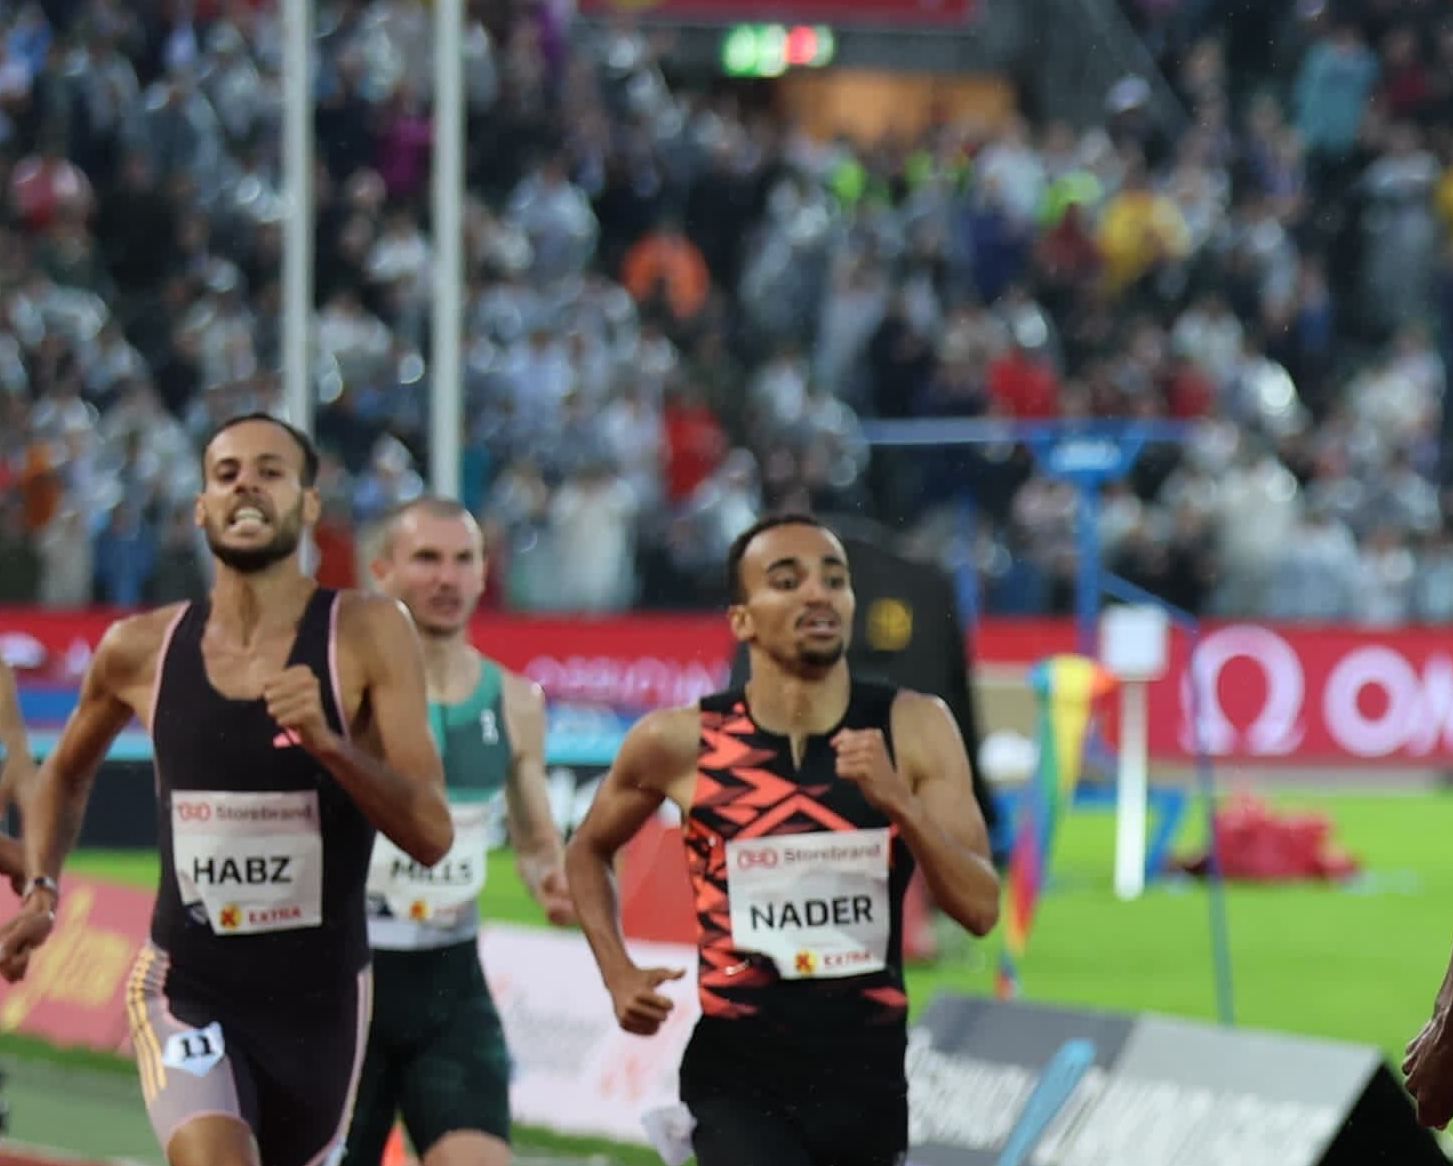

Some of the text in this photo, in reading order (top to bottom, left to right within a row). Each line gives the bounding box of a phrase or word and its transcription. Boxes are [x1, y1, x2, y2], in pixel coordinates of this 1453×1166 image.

[216, 803, 313, 820] Storebrand
[784, 843, 881, 862] Storebrand
[193, 855, 293, 885] HABZ
[750, 894, 874, 931] NADER
[181, 1035, 216, 1062] 11
